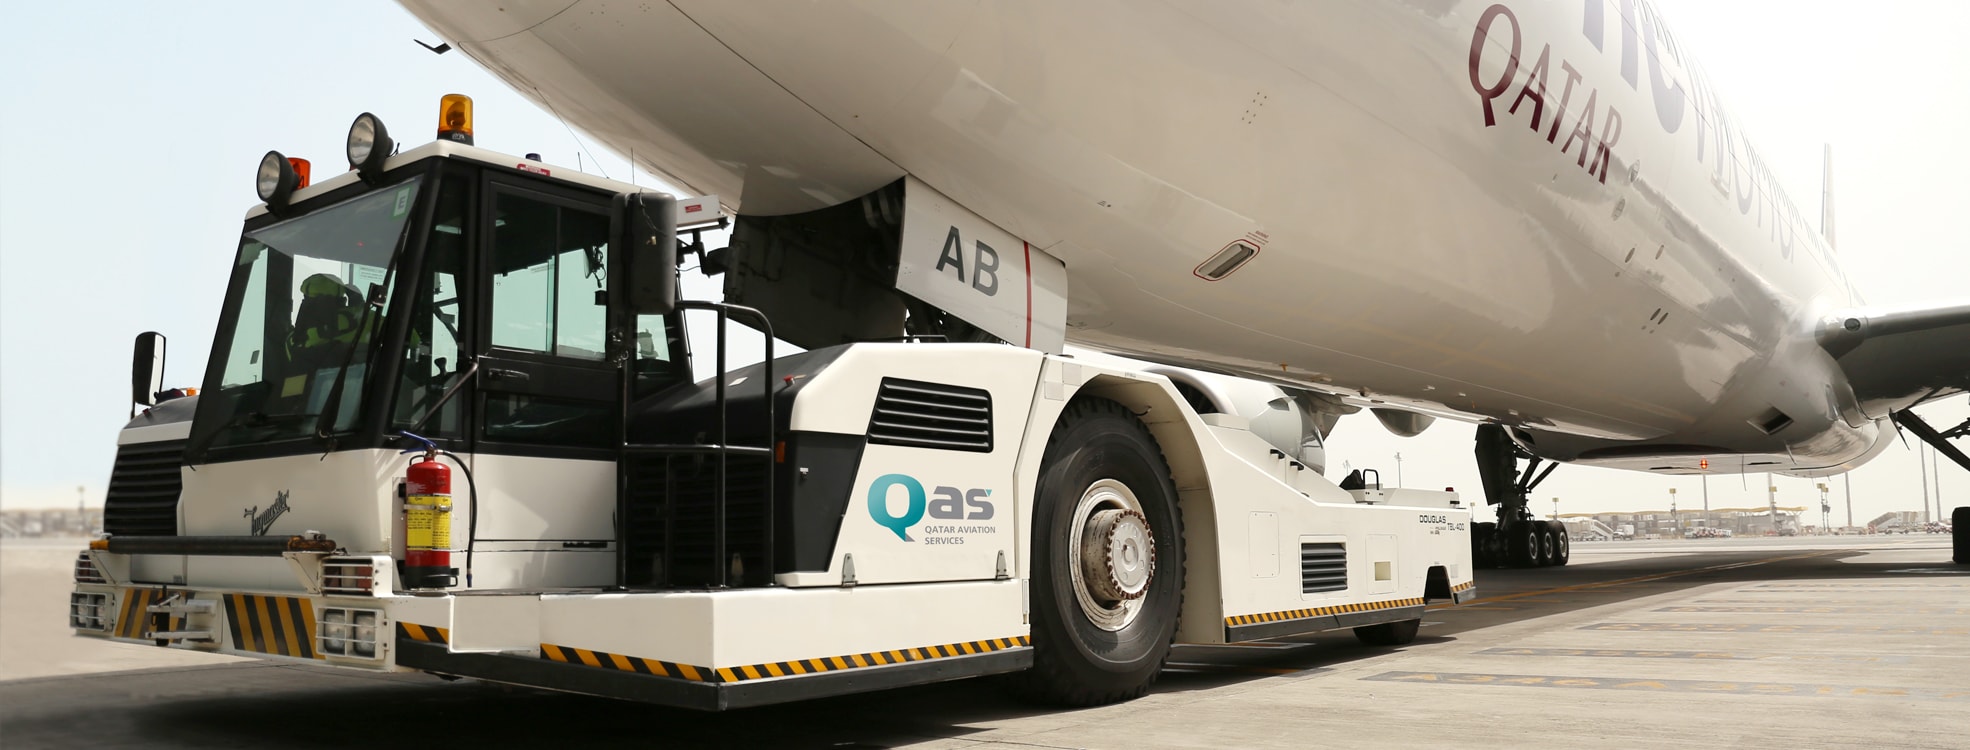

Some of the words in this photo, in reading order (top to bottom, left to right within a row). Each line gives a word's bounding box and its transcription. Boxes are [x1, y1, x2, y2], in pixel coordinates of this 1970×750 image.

[1468, 3, 1622, 185] QATAR
[935, 225, 1000, 297] AB
[867, 473, 995, 543] Qas
[1419, 514, 1447, 524] DOUGLAS
[924, 525, 955, 534] QATAR
[957, 526, 996, 534] AVIATION
[924, 536, 965, 545] SERVICES
